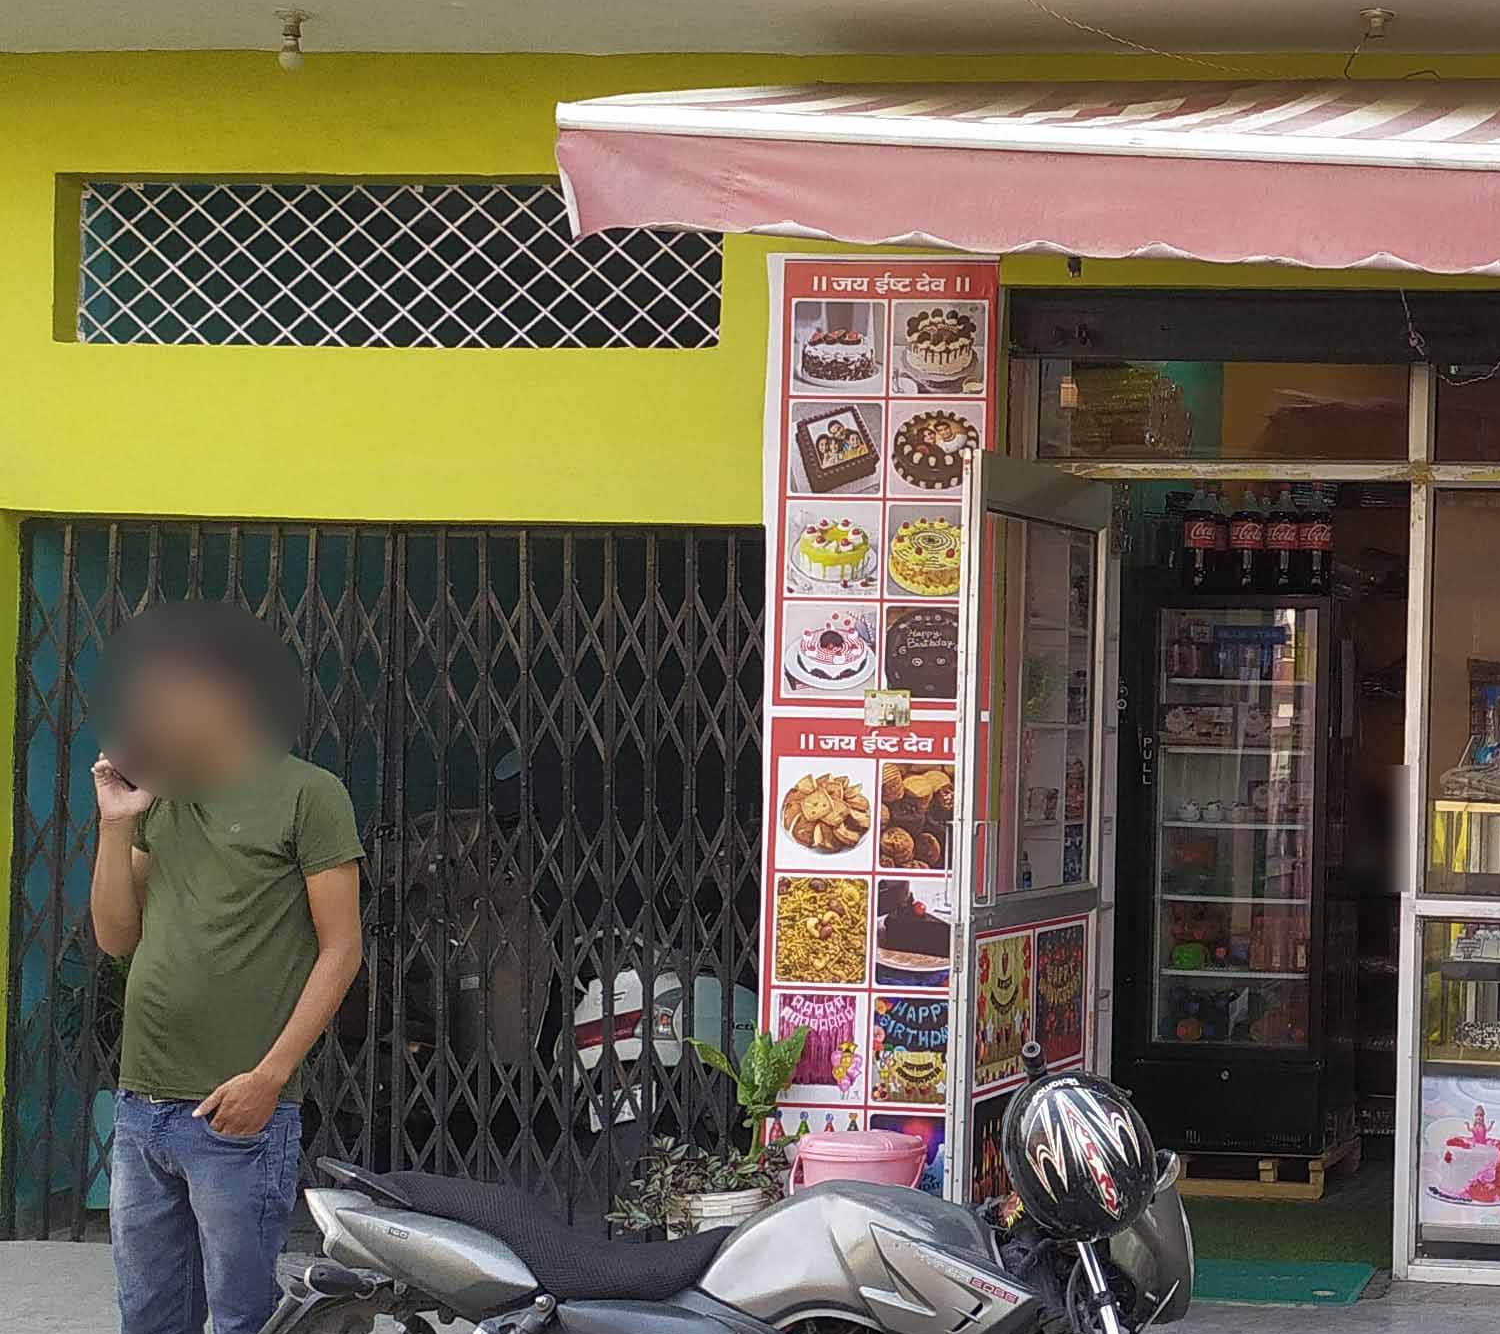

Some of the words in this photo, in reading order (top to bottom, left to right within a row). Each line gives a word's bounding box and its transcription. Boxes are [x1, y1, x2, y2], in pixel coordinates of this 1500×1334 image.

[831, 276, 870, 292] जय
[874, 272, 913, 294] ईष्ट
[915, 273, 946, 292] देव
[818, 734, 858, 751] जय
[862, 731, 899, 753] ईष्ट
[903, 732, 934, 752] देव
[1142, 737, 1153, 785] PULL
[892, 1000, 949, 1023] HAPP
